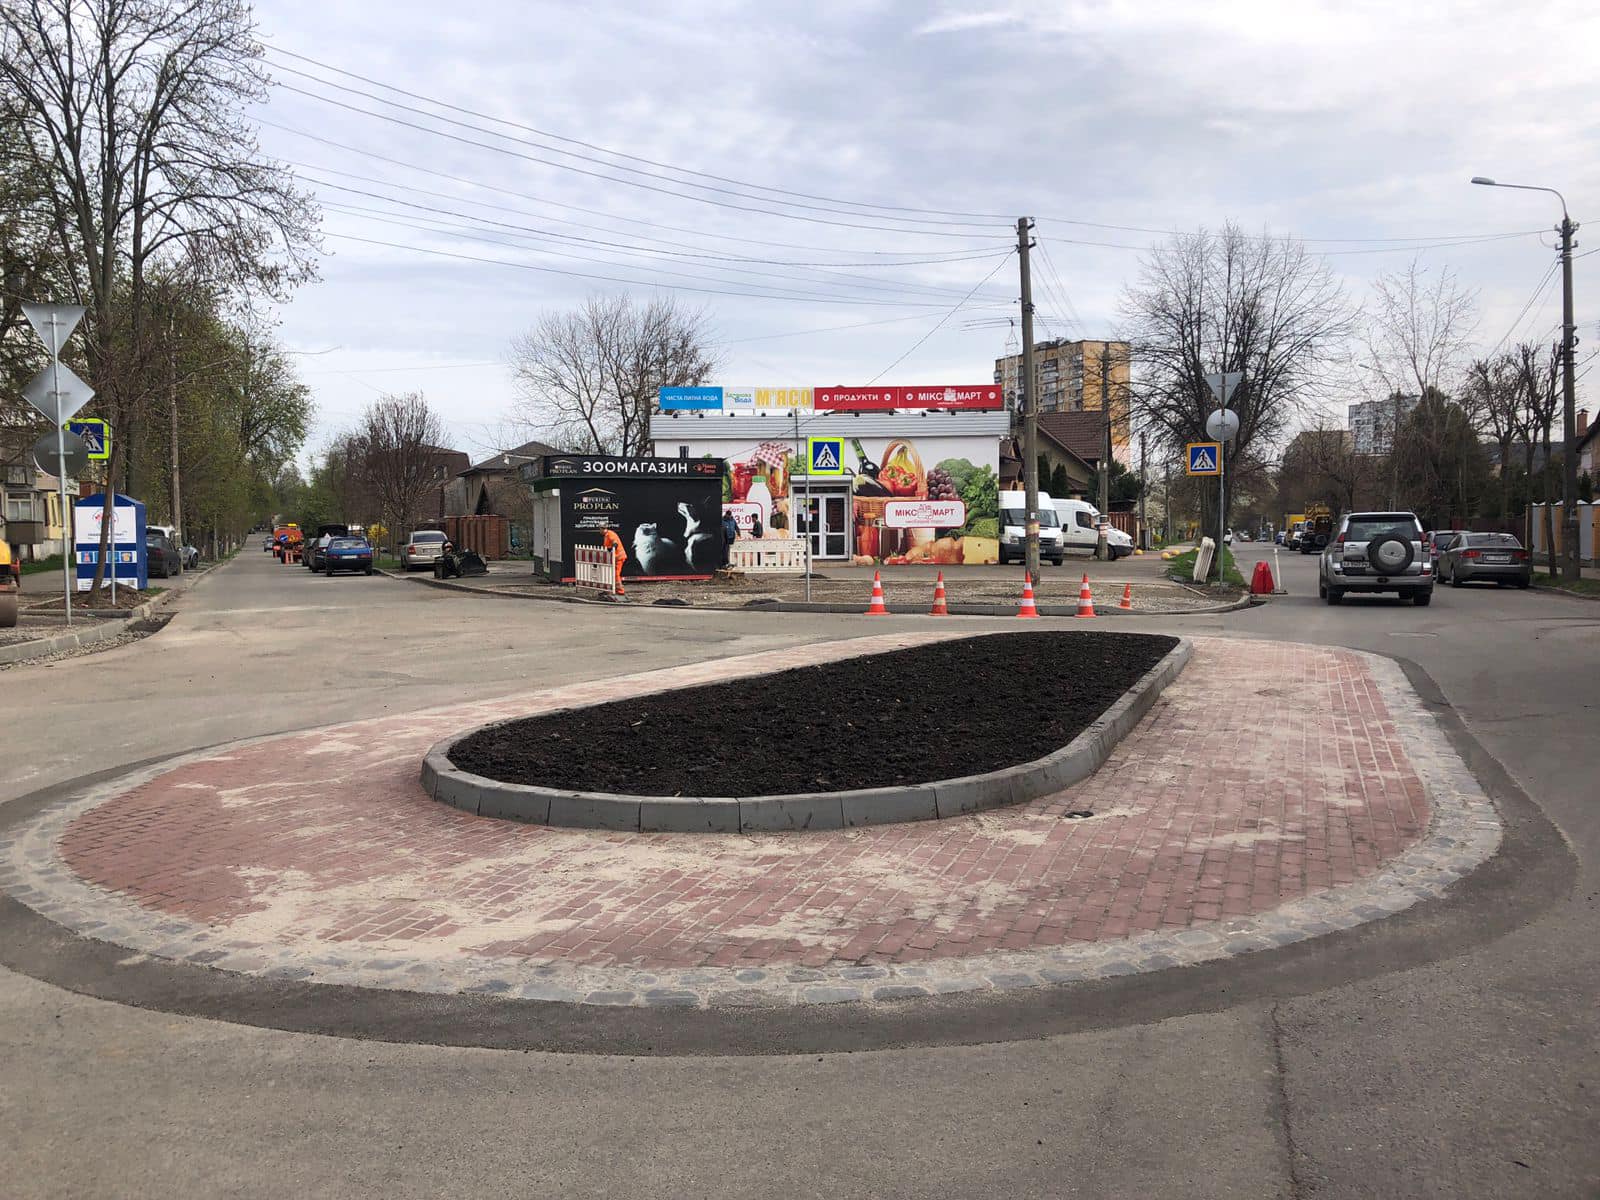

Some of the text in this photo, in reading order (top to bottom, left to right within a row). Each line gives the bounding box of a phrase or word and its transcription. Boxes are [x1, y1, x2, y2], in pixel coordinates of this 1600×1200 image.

[833, 393, 879, 401] ПРОДУКТИ
[918, 391, 982, 401] МІКС МАРТ
[583, 461, 688, 474] ЗООМАГАЗИН
[895, 508, 955, 517] МІКС МАРТ
